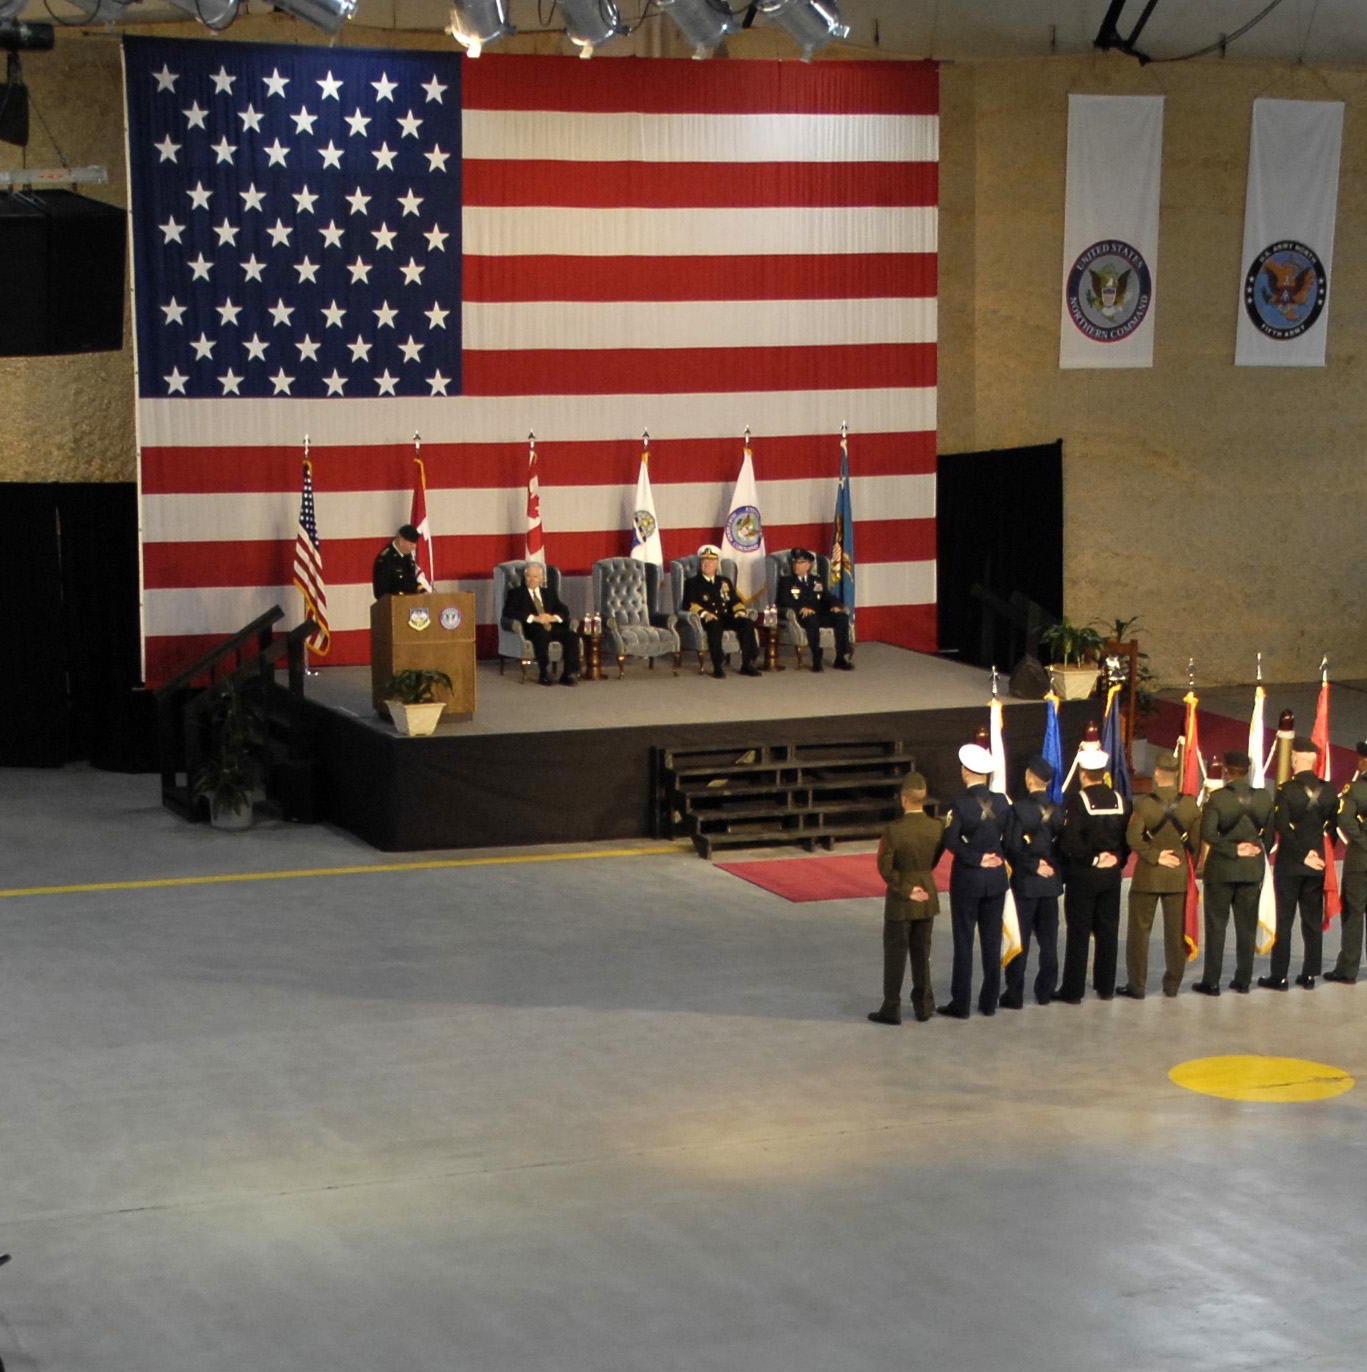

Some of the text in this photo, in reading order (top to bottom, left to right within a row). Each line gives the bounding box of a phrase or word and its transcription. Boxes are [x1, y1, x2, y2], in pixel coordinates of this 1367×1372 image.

[1076, 243, 1143, 271] UNITED STATES
[1273, 242, 1293, 252] ARMY
[1295, 244, 1317, 264] NORTH
[1069, 295, 1148, 339] NORTHERN COMMAND
[1260, 323, 1305, 337] FIFTH ARMY
